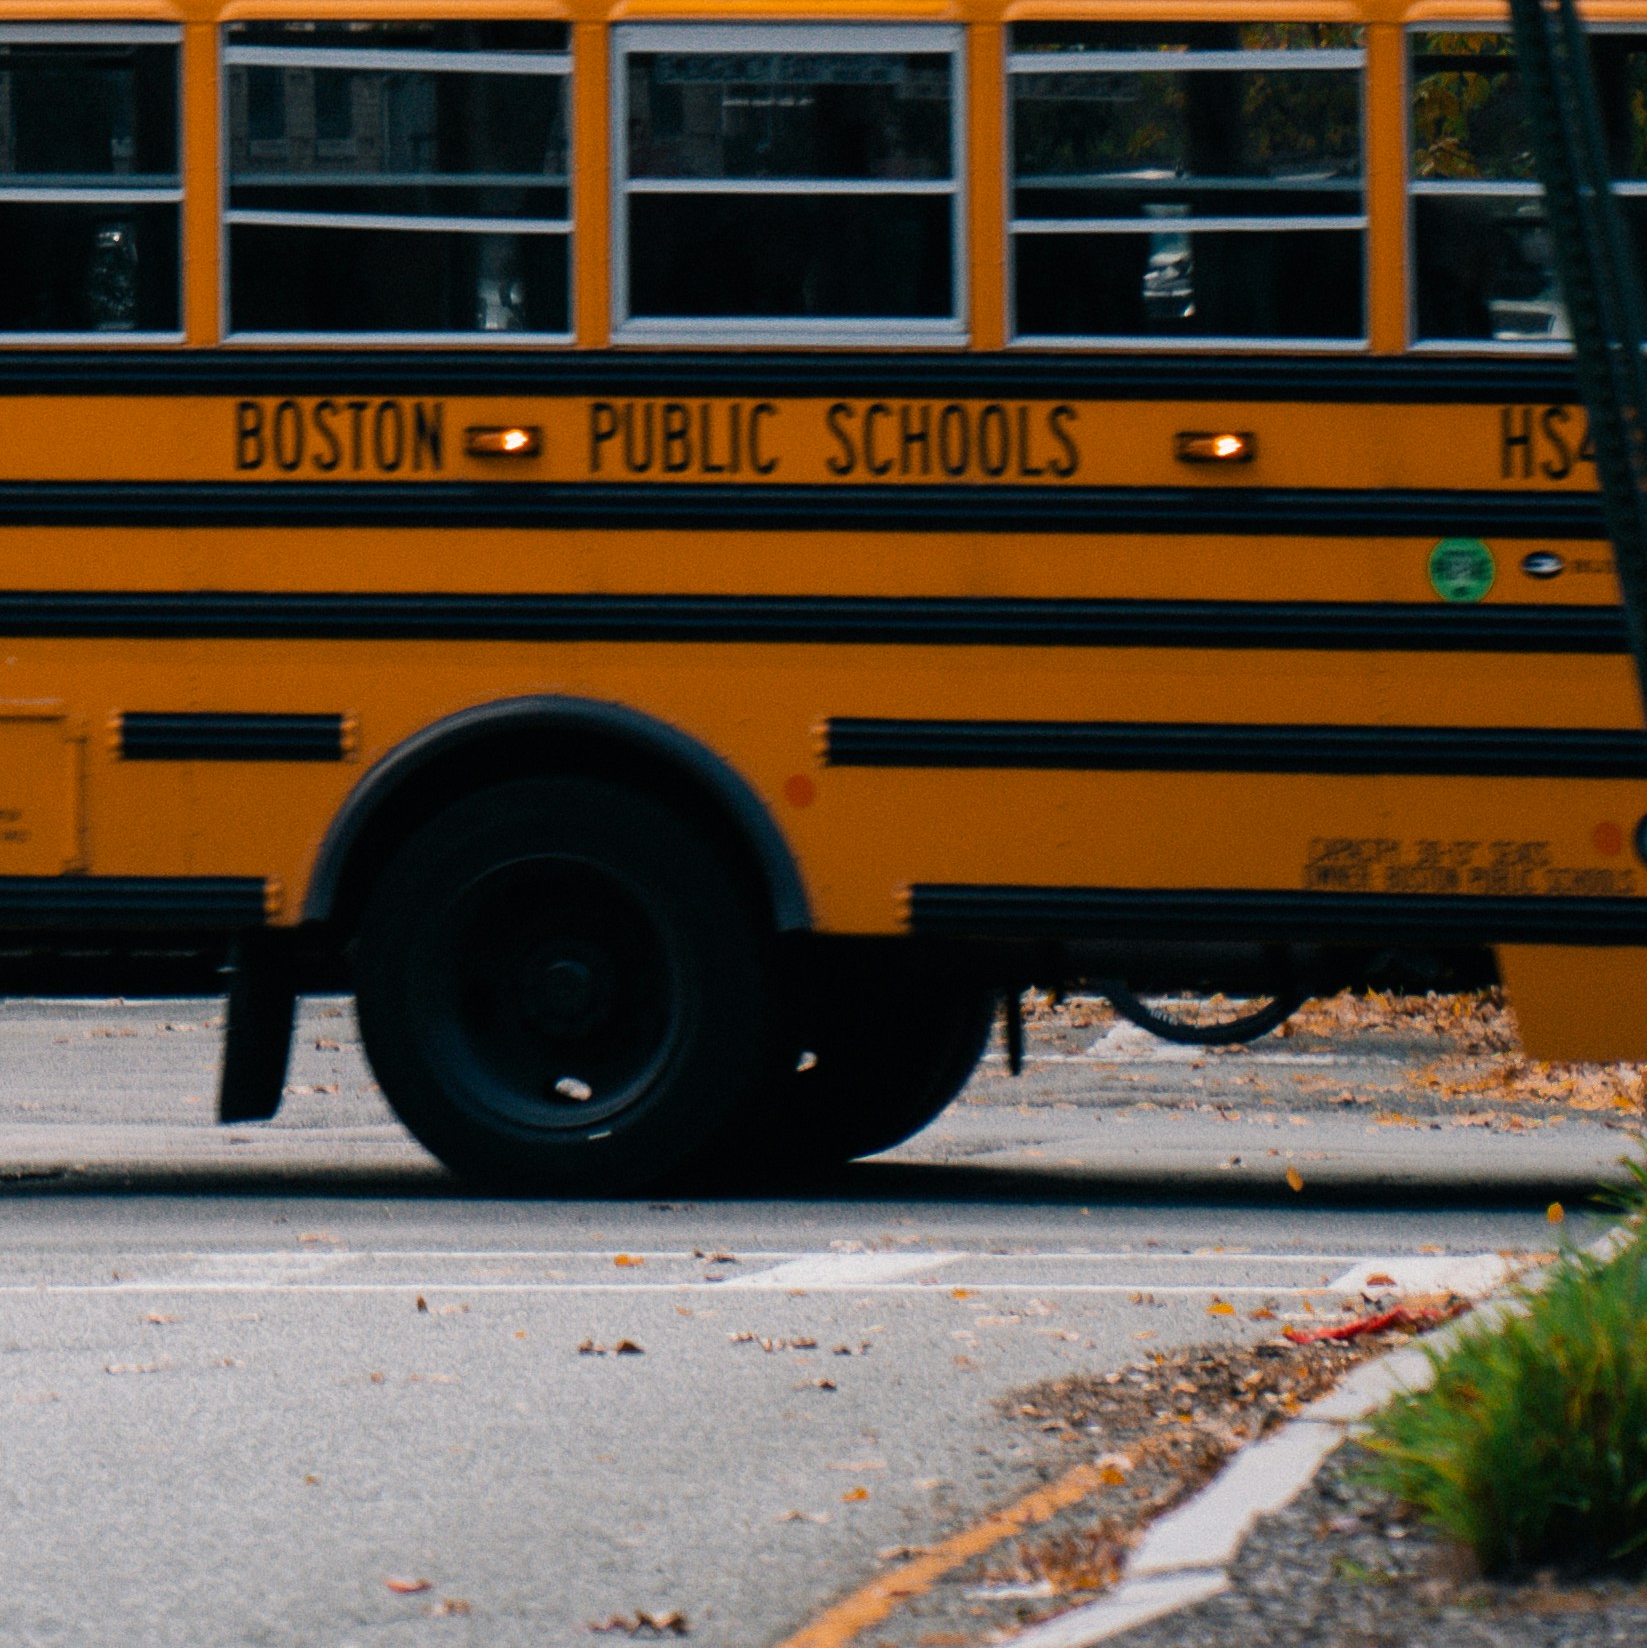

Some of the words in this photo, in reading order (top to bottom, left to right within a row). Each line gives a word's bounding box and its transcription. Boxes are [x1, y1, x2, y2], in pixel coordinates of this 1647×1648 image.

[235, 399, 444, 473] BOSTON
[588, 401, 781, 475] PUBLIC
[825, 402, 1081, 479] SCHOOLS
